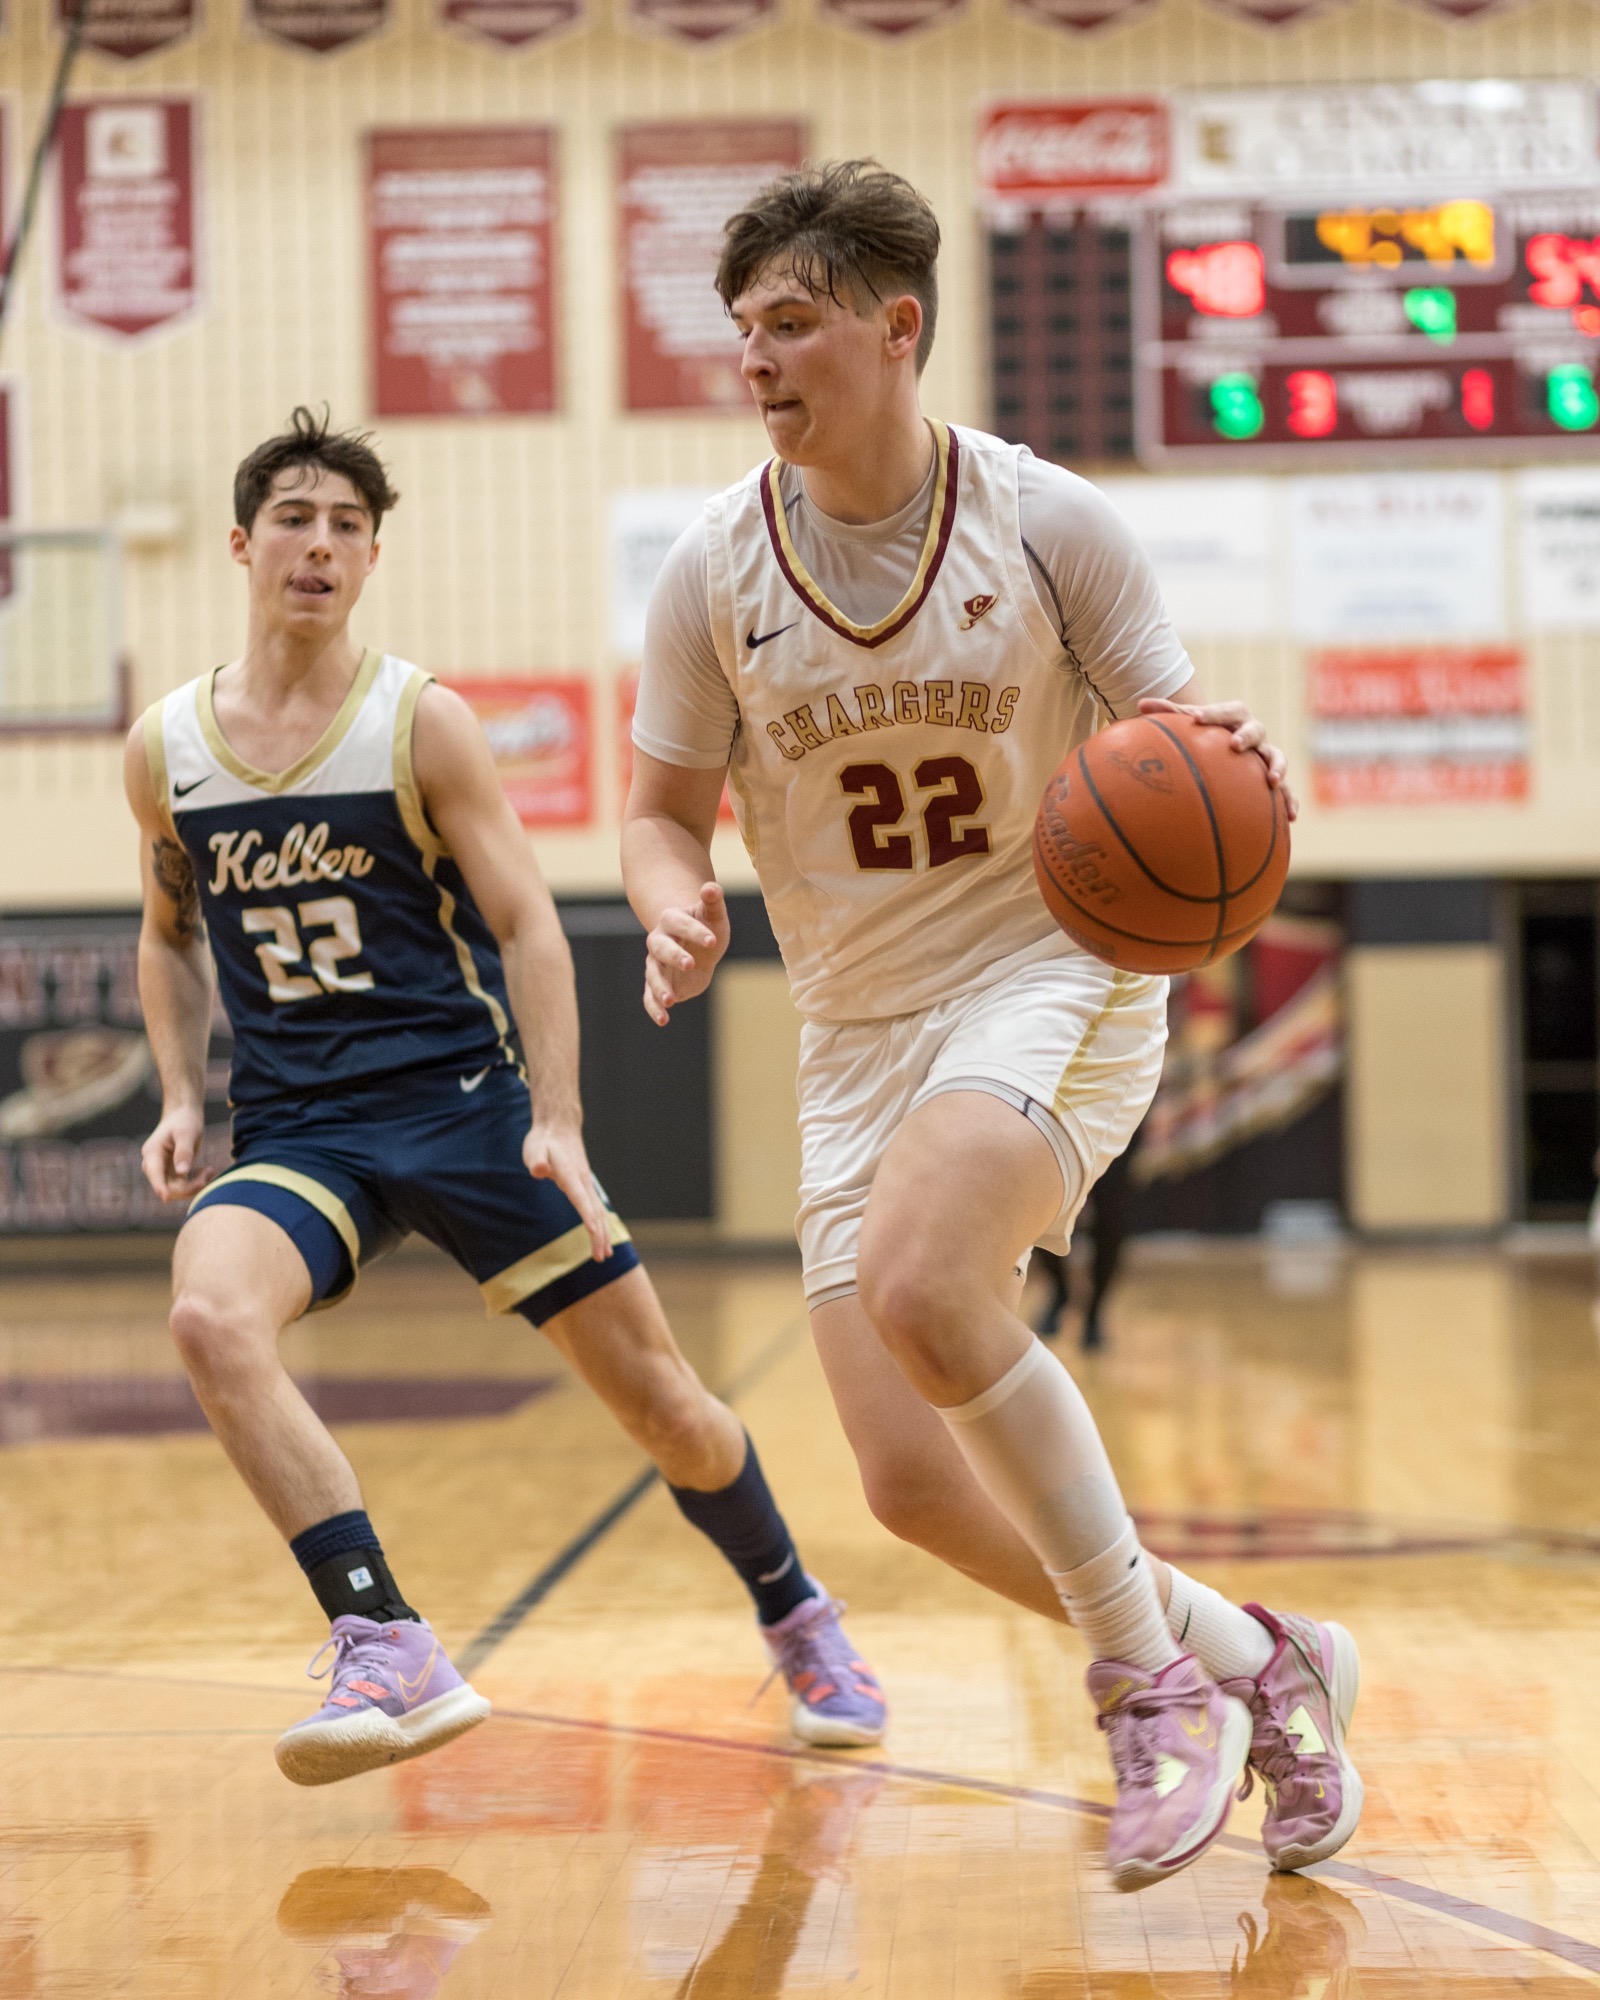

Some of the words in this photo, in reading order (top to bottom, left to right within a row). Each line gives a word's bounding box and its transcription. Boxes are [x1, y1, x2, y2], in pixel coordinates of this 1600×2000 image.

[766, 680, 1021, 761] CHARGERS
[207, 821, 376, 896] Keller
[835, 752, 993, 874] 22
[241, 895, 376, 1004] 22
